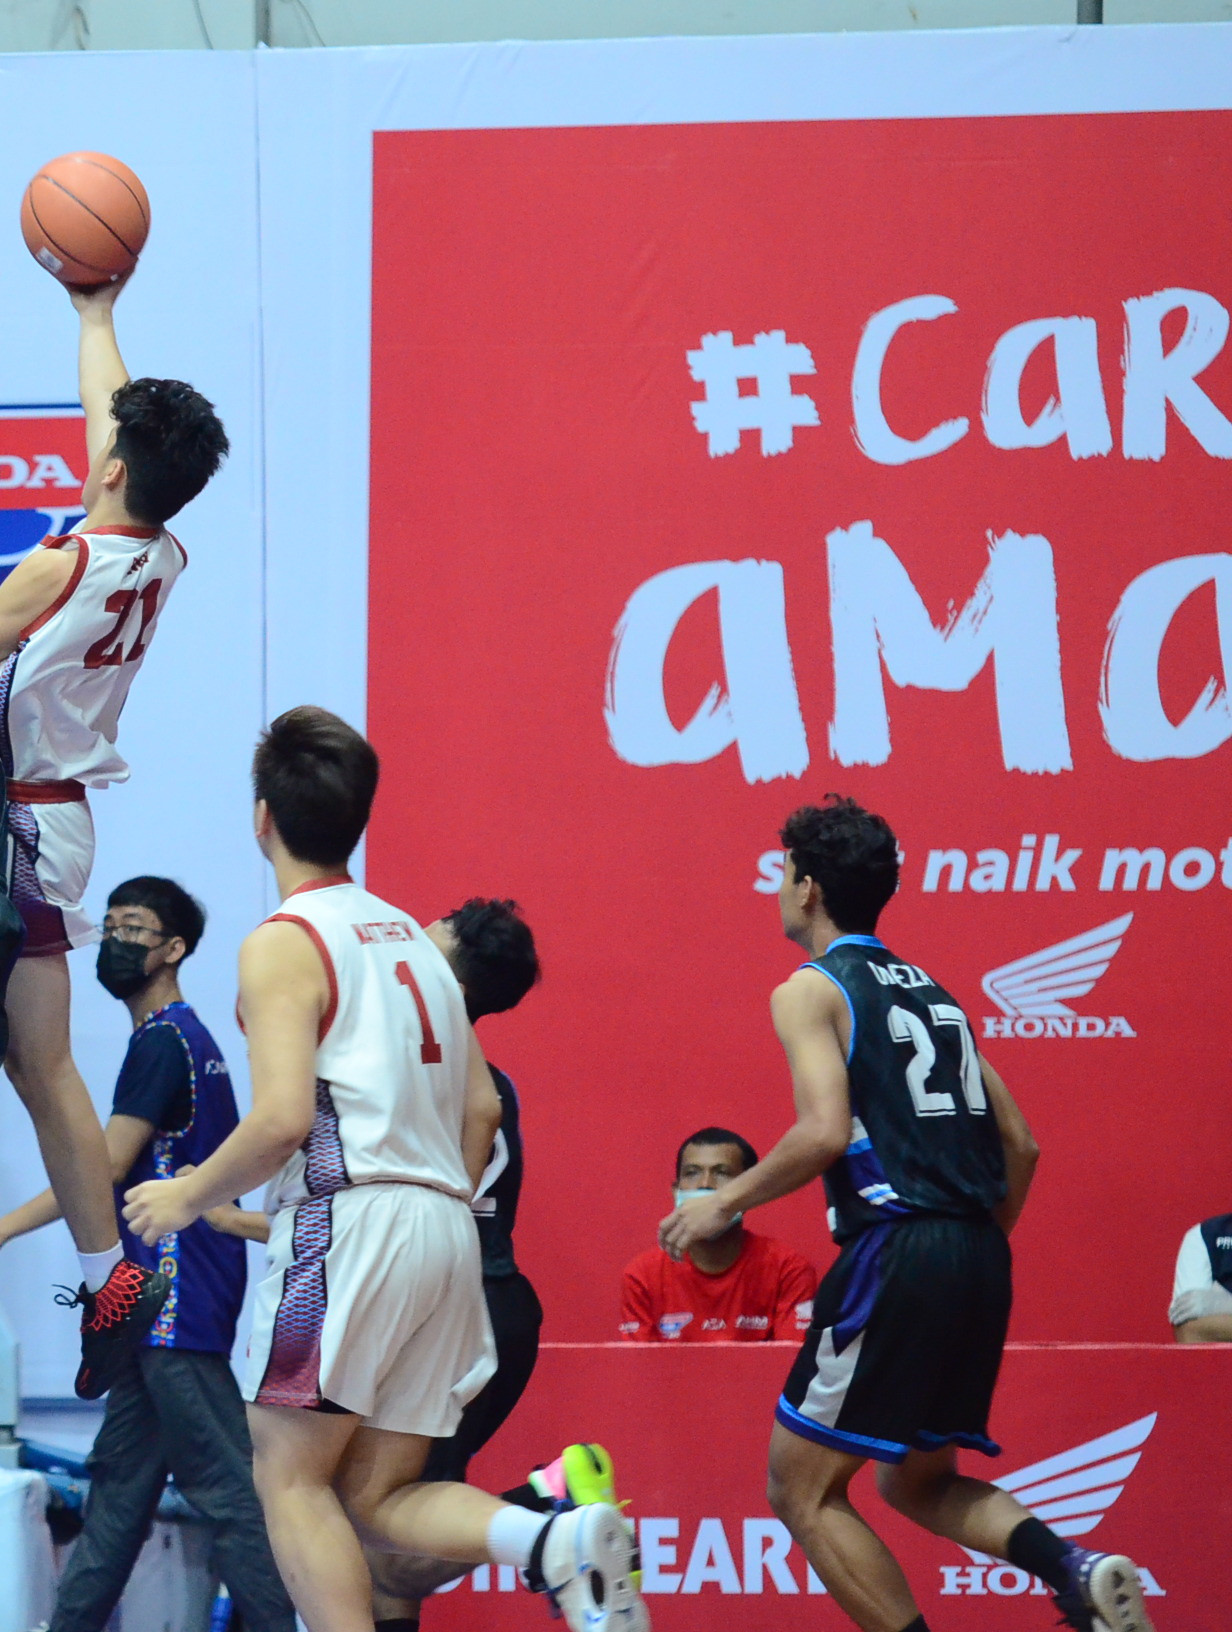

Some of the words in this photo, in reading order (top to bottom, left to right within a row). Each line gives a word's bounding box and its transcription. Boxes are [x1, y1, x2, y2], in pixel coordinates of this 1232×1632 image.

[83, 578, 162, 669] 21
[922, 833, 1082, 893] naik
[394, 960, 442, 1064] 1
[982, 1016, 1137, 1039] HONDA
[887, 1003, 987, 1117] 27
[625, 1517, 828, 1594] EAR
[939, 1566, 1167, 1596] HOA
